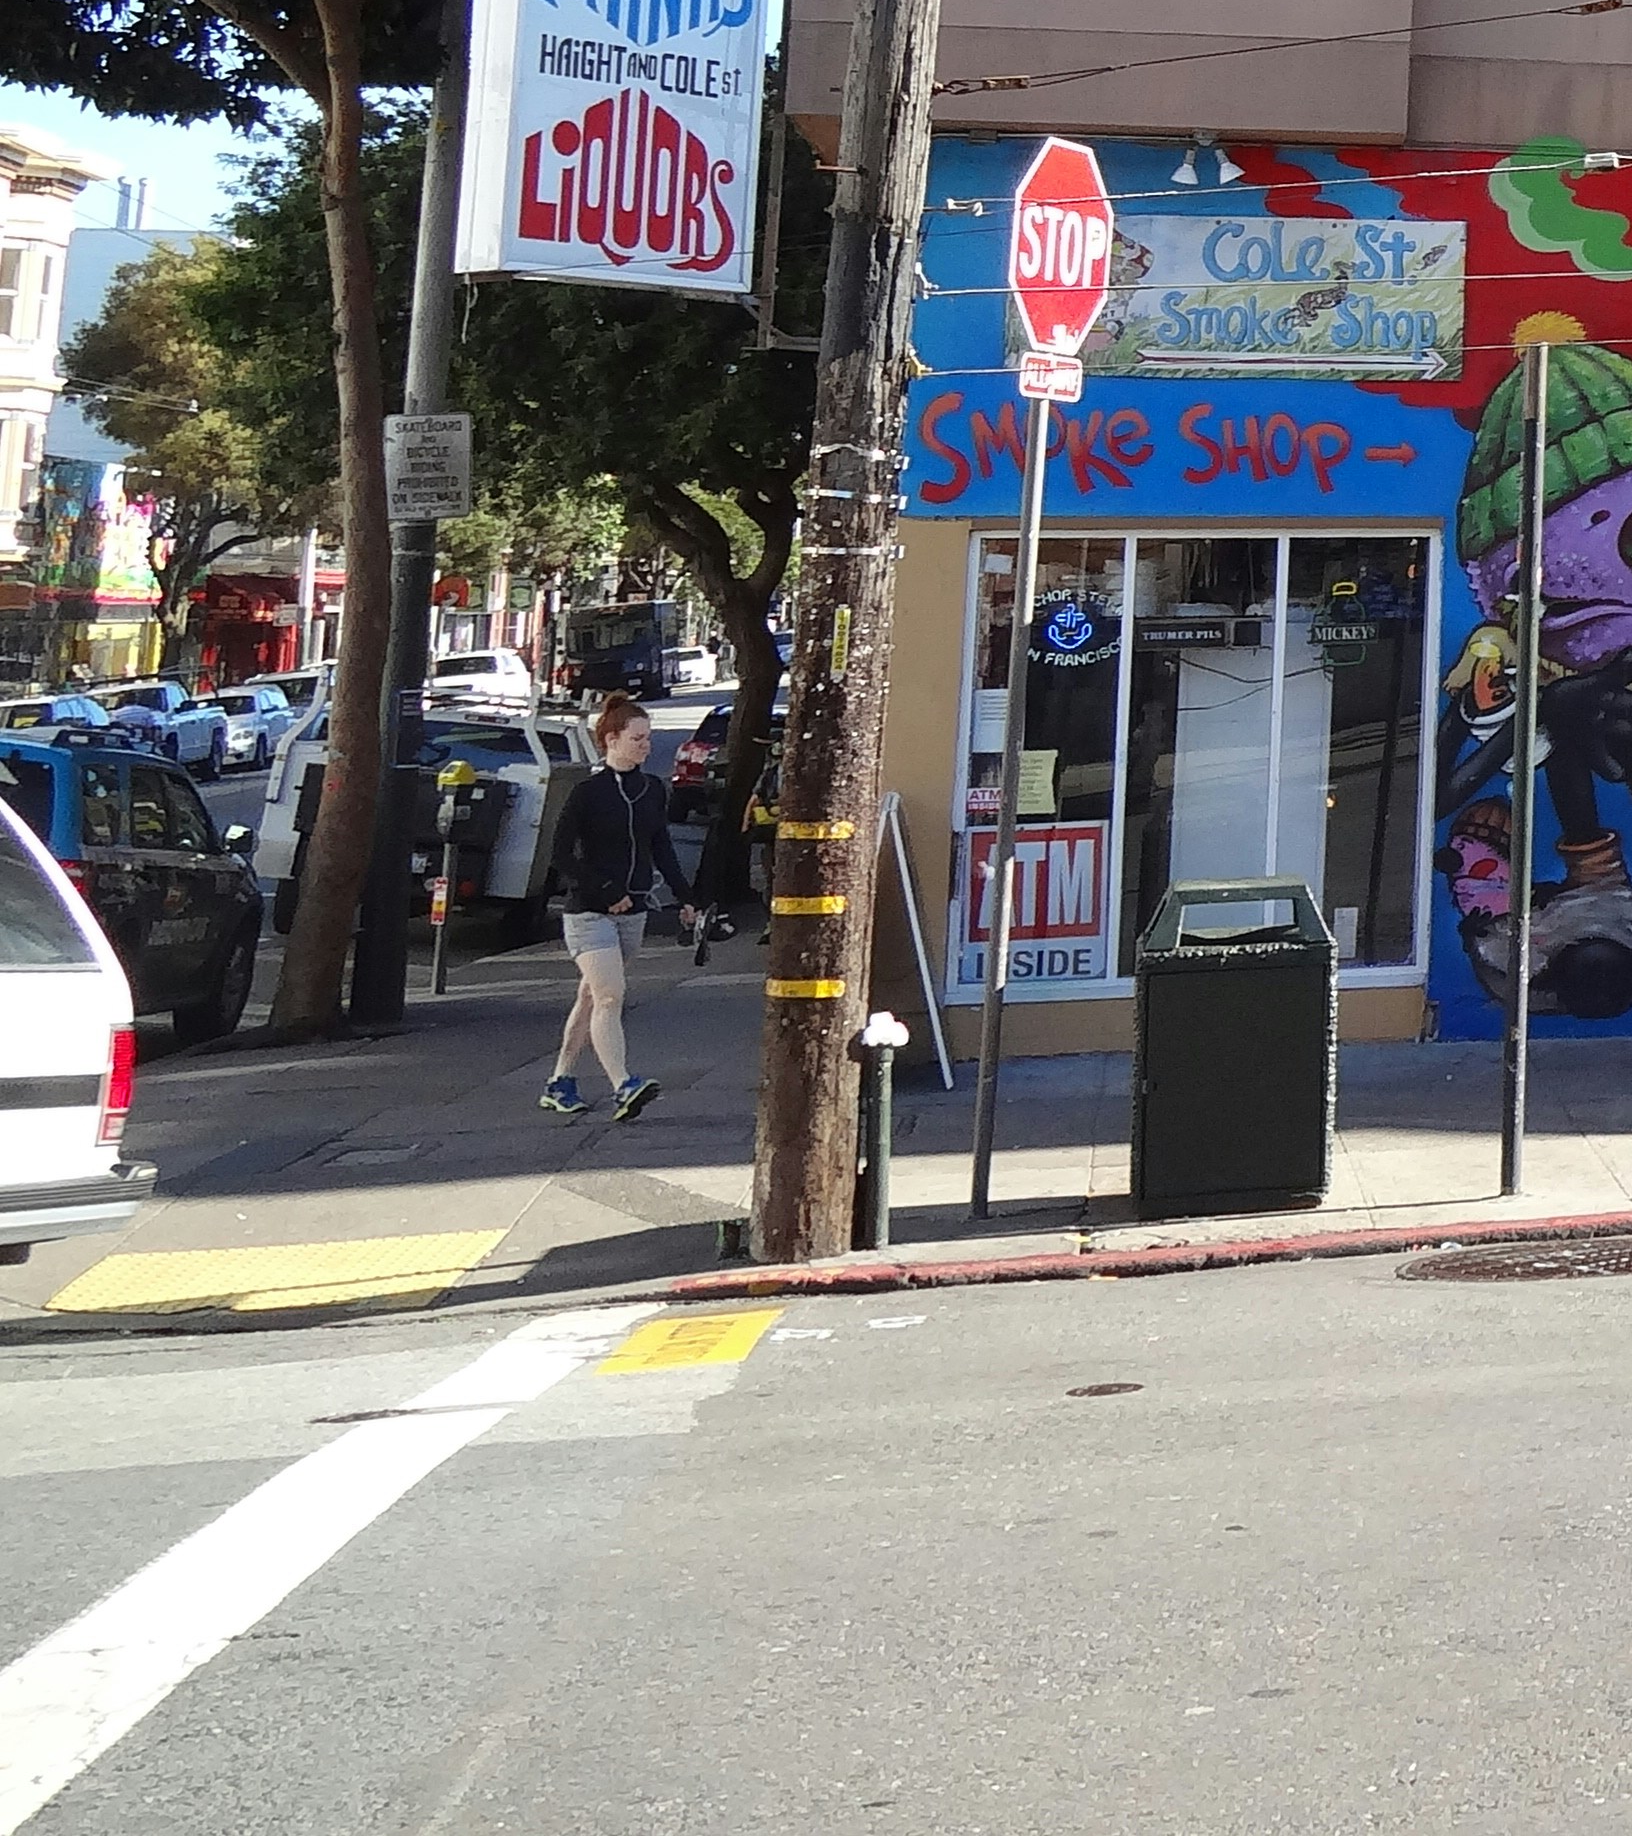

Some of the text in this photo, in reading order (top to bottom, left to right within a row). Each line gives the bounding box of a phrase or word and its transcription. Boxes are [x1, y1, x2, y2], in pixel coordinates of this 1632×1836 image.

[627, 52, 658, 81] AND
[660, 53, 720, 98] COLE
[1019, 202, 1107, 288] STOP
[1156, 291, 1437, 361] Smoke Shop
[395, 419, 462, 434] SKATEBOARD
[406, 446, 451, 459] BICYCLE
[1179, 404, 1351, 494] SHOP
[392, 491, 463, 505] ON SIDEWALK
[1141, 629, 1223, 642] TRUMER PILS
[969, 789, 1002, 800] ATM
[976, 948, 1092, 978] ISIDE
